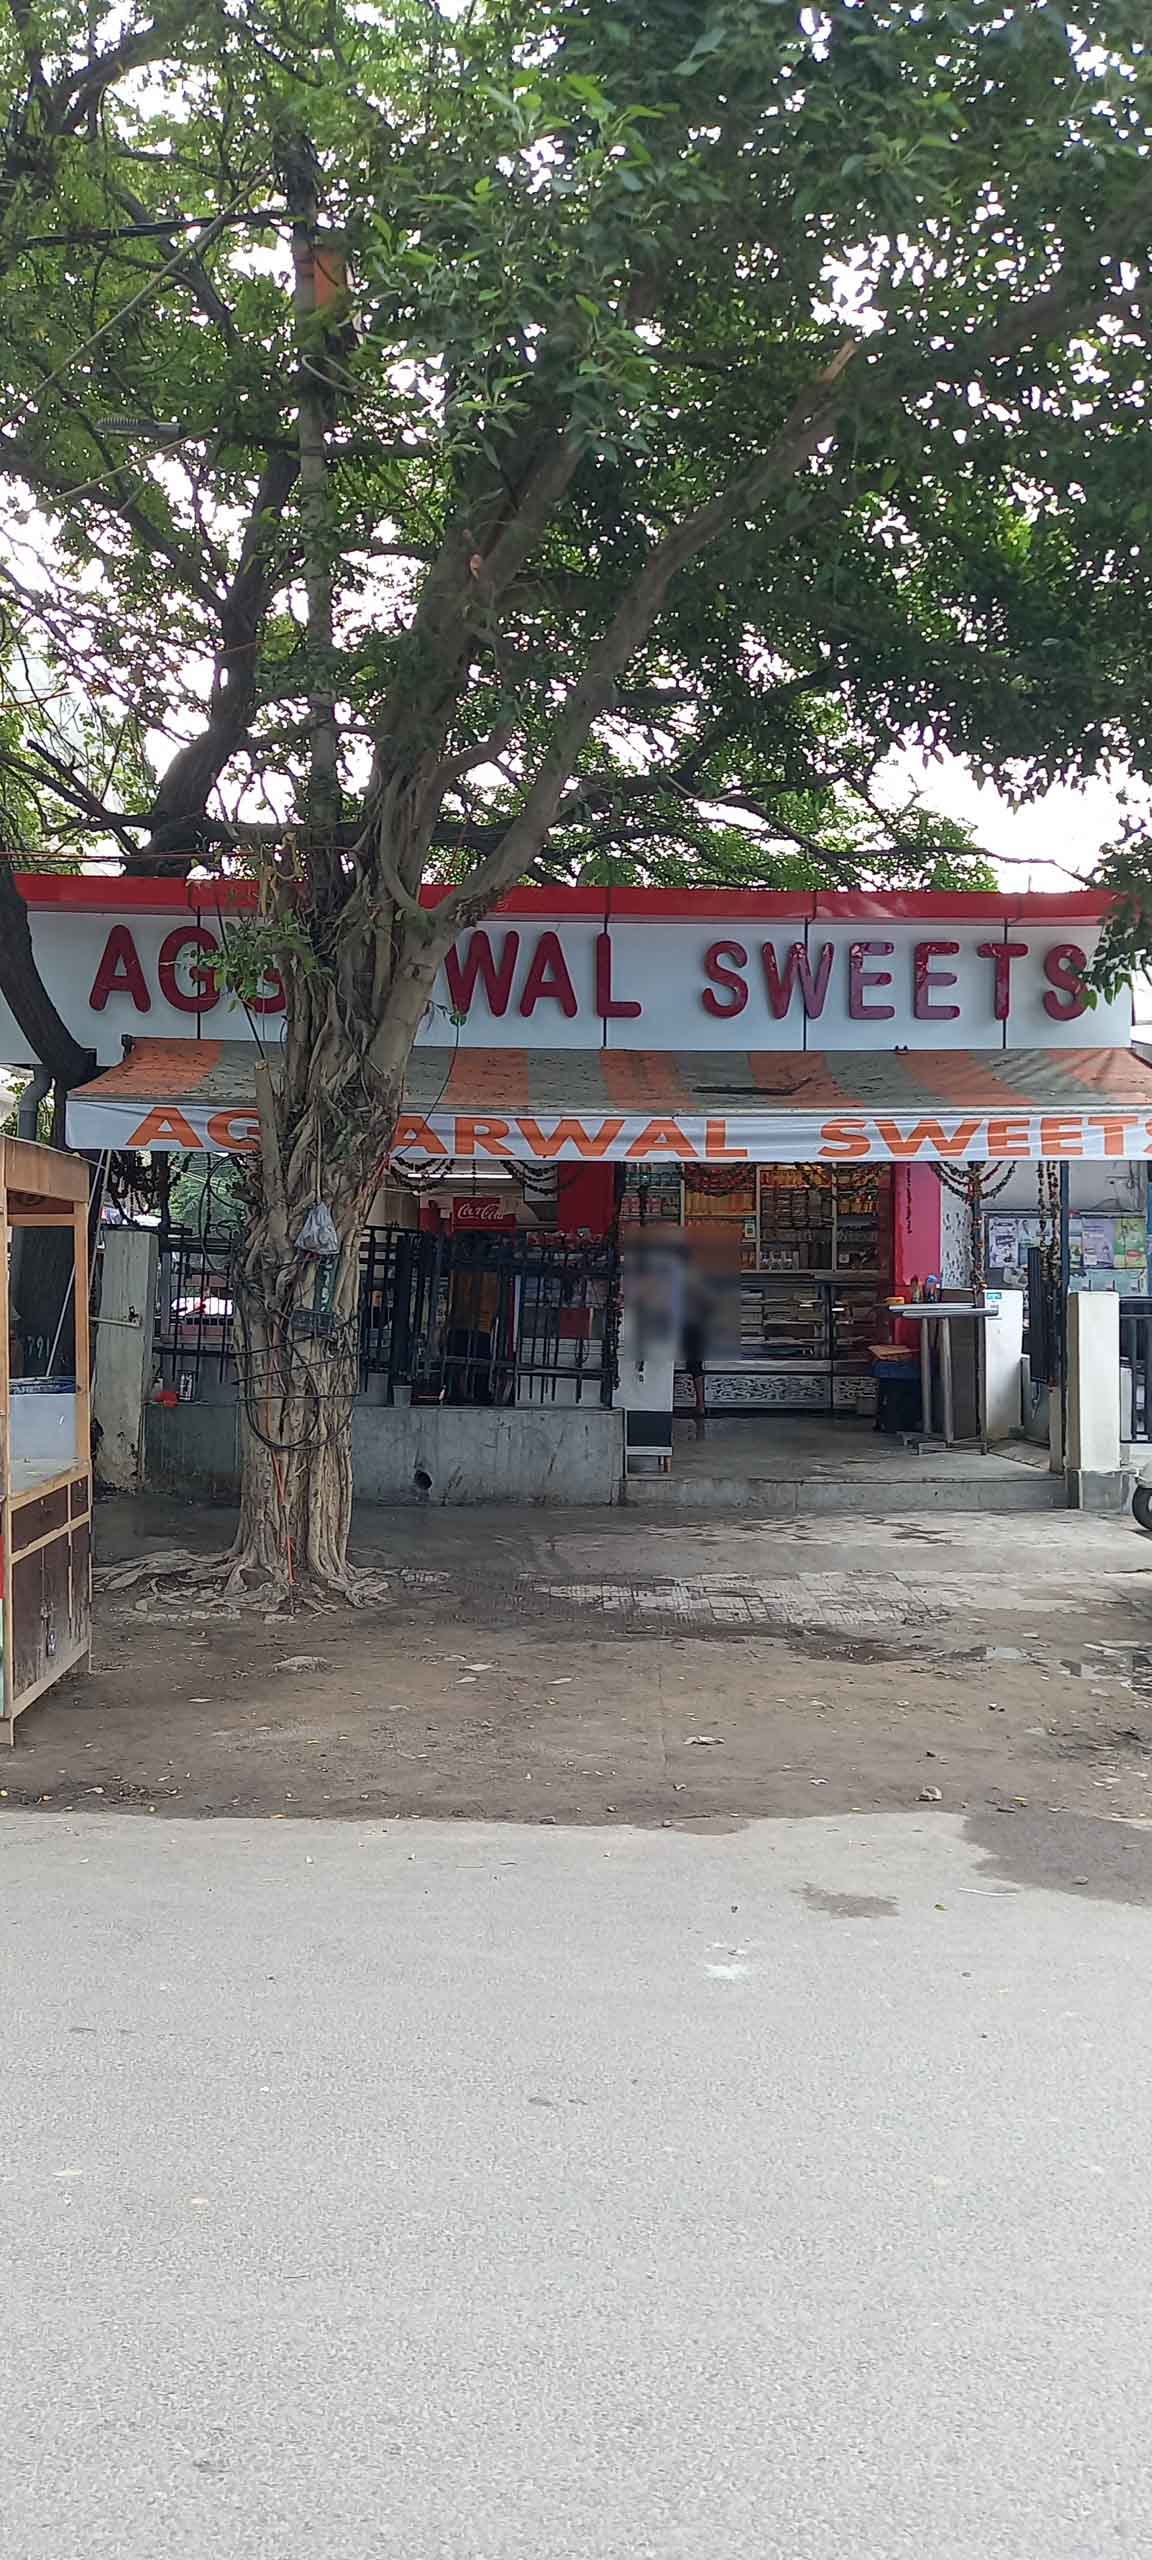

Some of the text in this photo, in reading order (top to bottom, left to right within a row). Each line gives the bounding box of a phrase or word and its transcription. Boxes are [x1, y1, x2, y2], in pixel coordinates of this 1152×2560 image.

[702, 940, 1089, 1021] SWEETS
[126, 1106, 1152, 1159] AGARWAL SWEET
